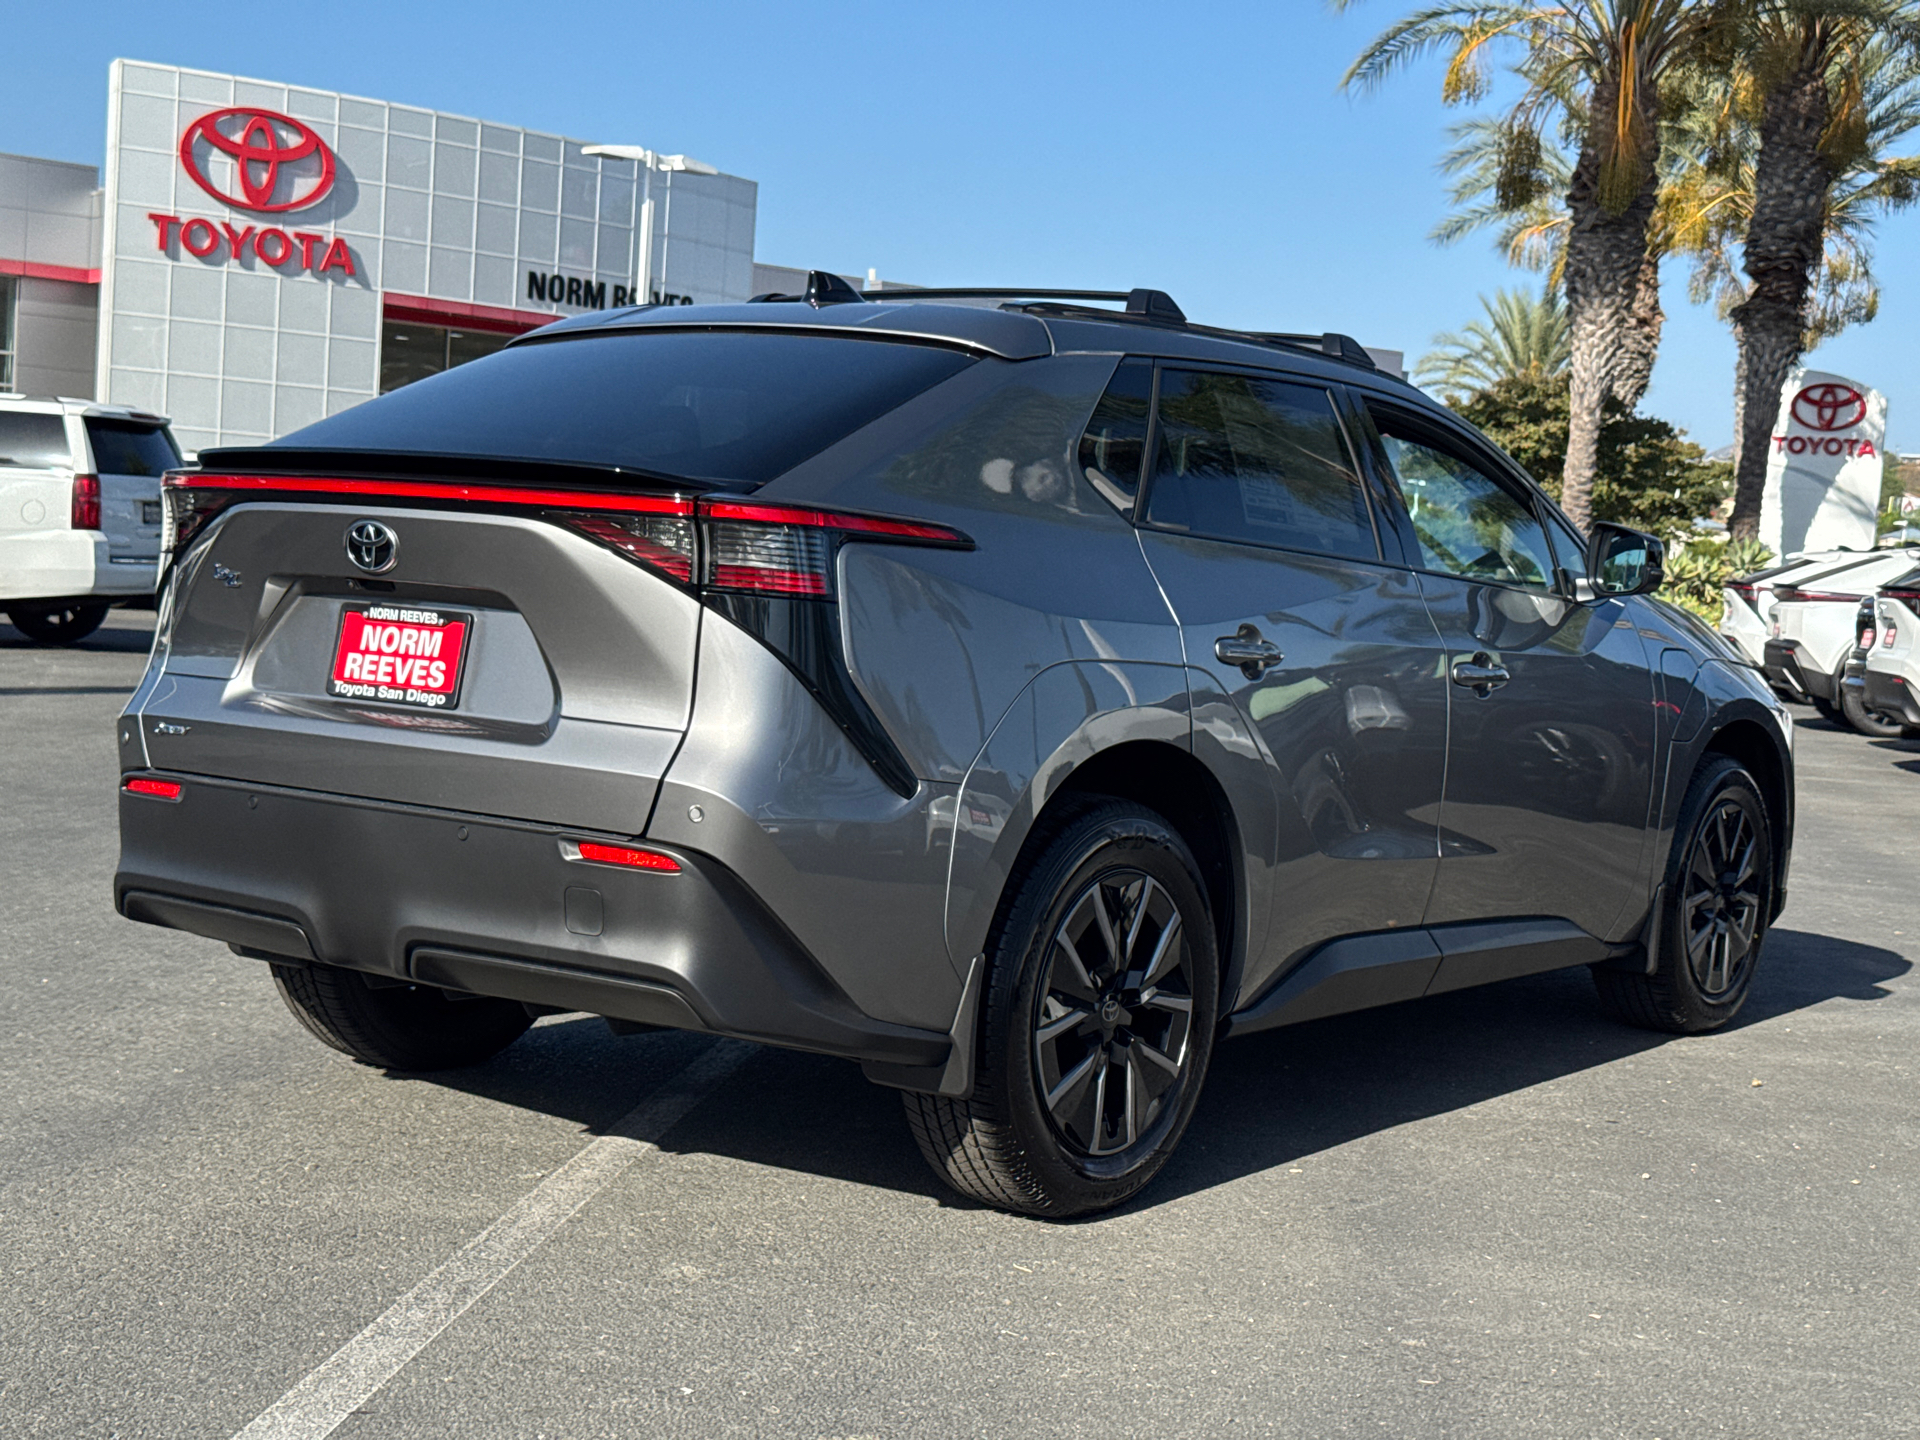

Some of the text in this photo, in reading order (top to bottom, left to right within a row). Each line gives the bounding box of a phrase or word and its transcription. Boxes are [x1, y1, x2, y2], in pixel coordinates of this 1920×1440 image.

[148, 213, 356, 275] TOYOTA
[528, 271, 606, 309] NORM
[1771, 436, 1876, 458] TOYOTA
[369, 607, 438, 624] NORM REEVES
[359, 624, 443, 657] NORM
[343, 652, 446, 688] REEVES
[334, 680, 446, 706] Toyota San Diego
